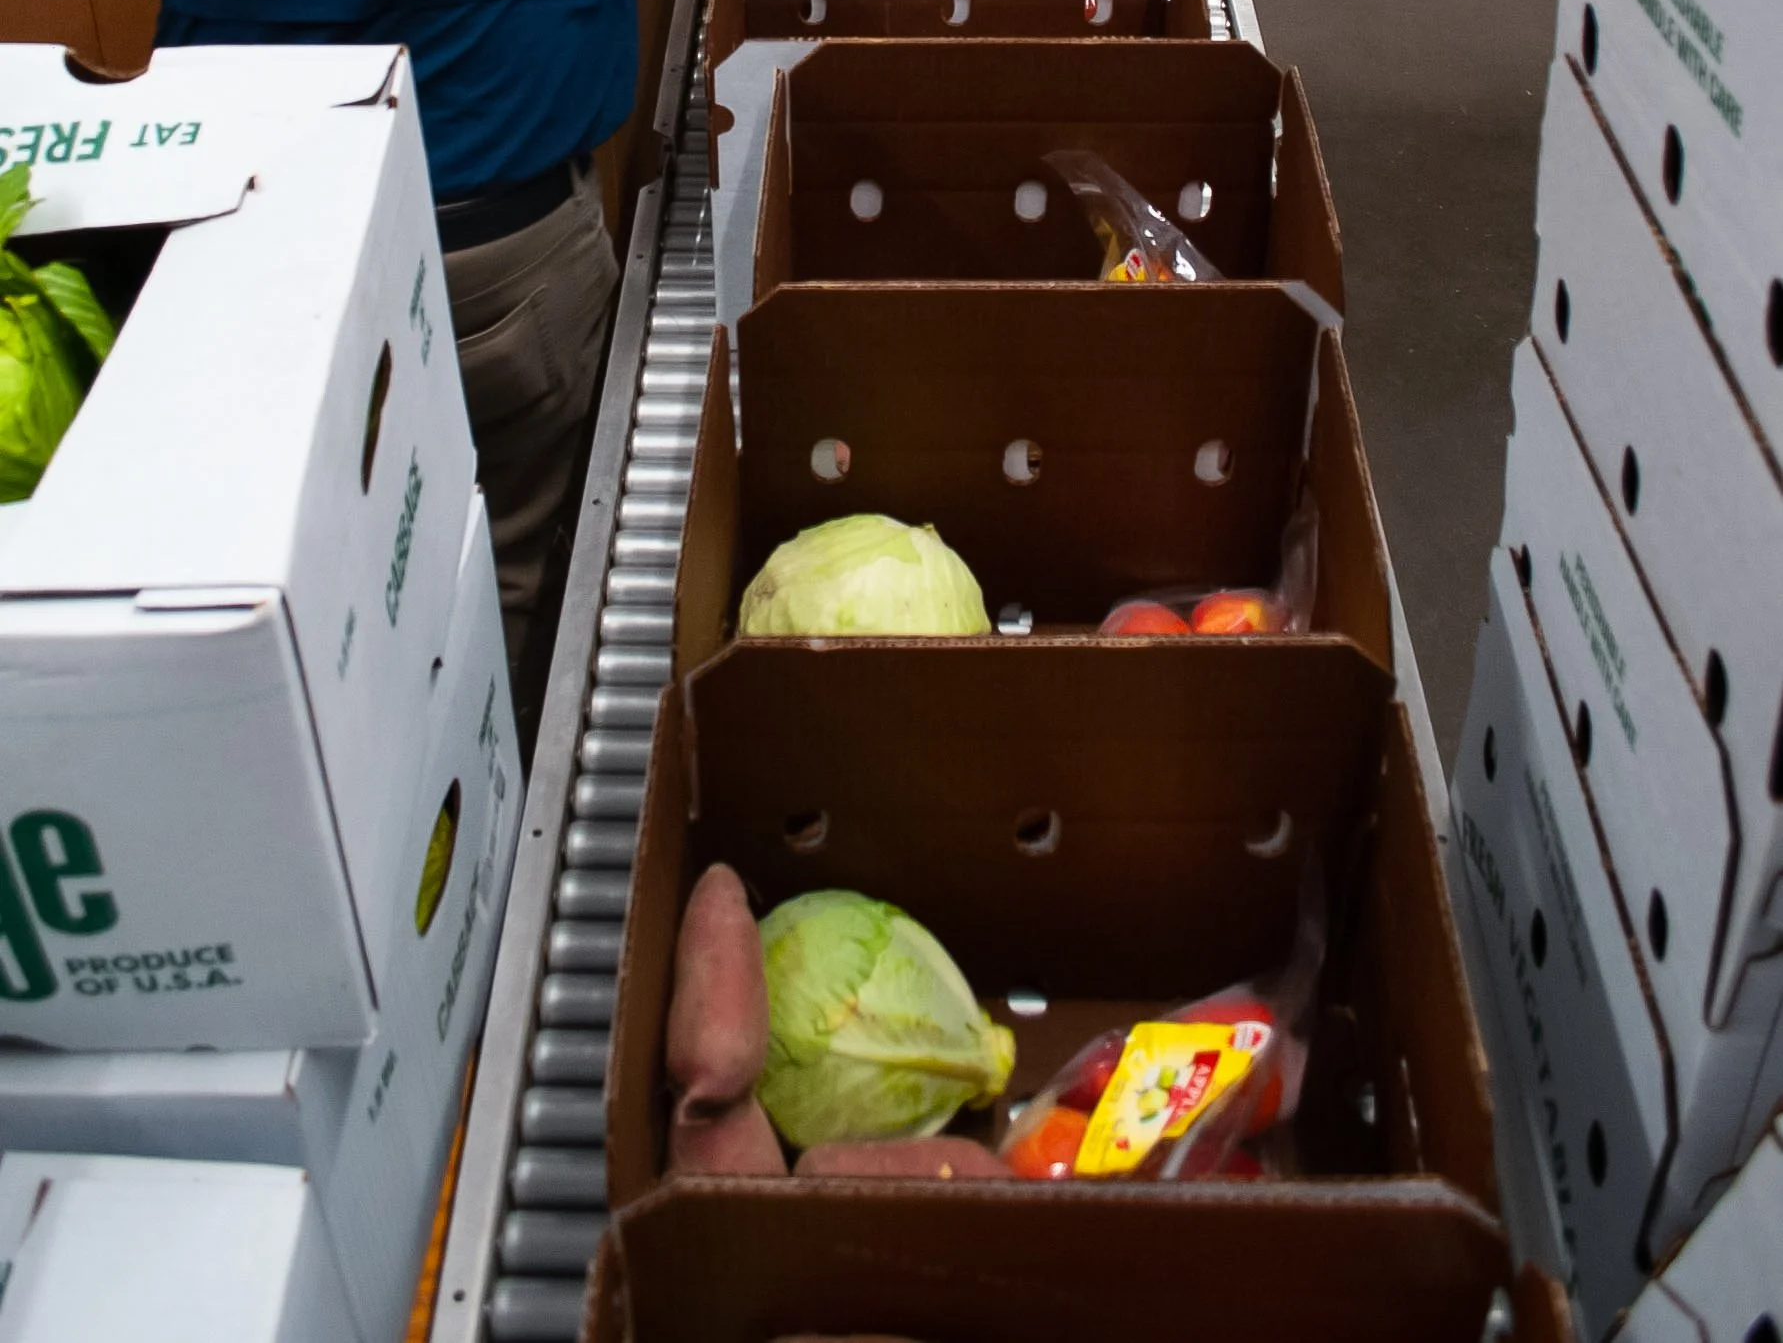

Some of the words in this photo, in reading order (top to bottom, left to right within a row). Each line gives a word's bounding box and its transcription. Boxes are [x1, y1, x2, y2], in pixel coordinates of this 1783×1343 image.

[129, 122, 202, 148] EAT
[64, 943, 236, 976] PRODUCE
[73, 977, 119, 996] OF
[133, 967, 243, 994] U.S.A.
